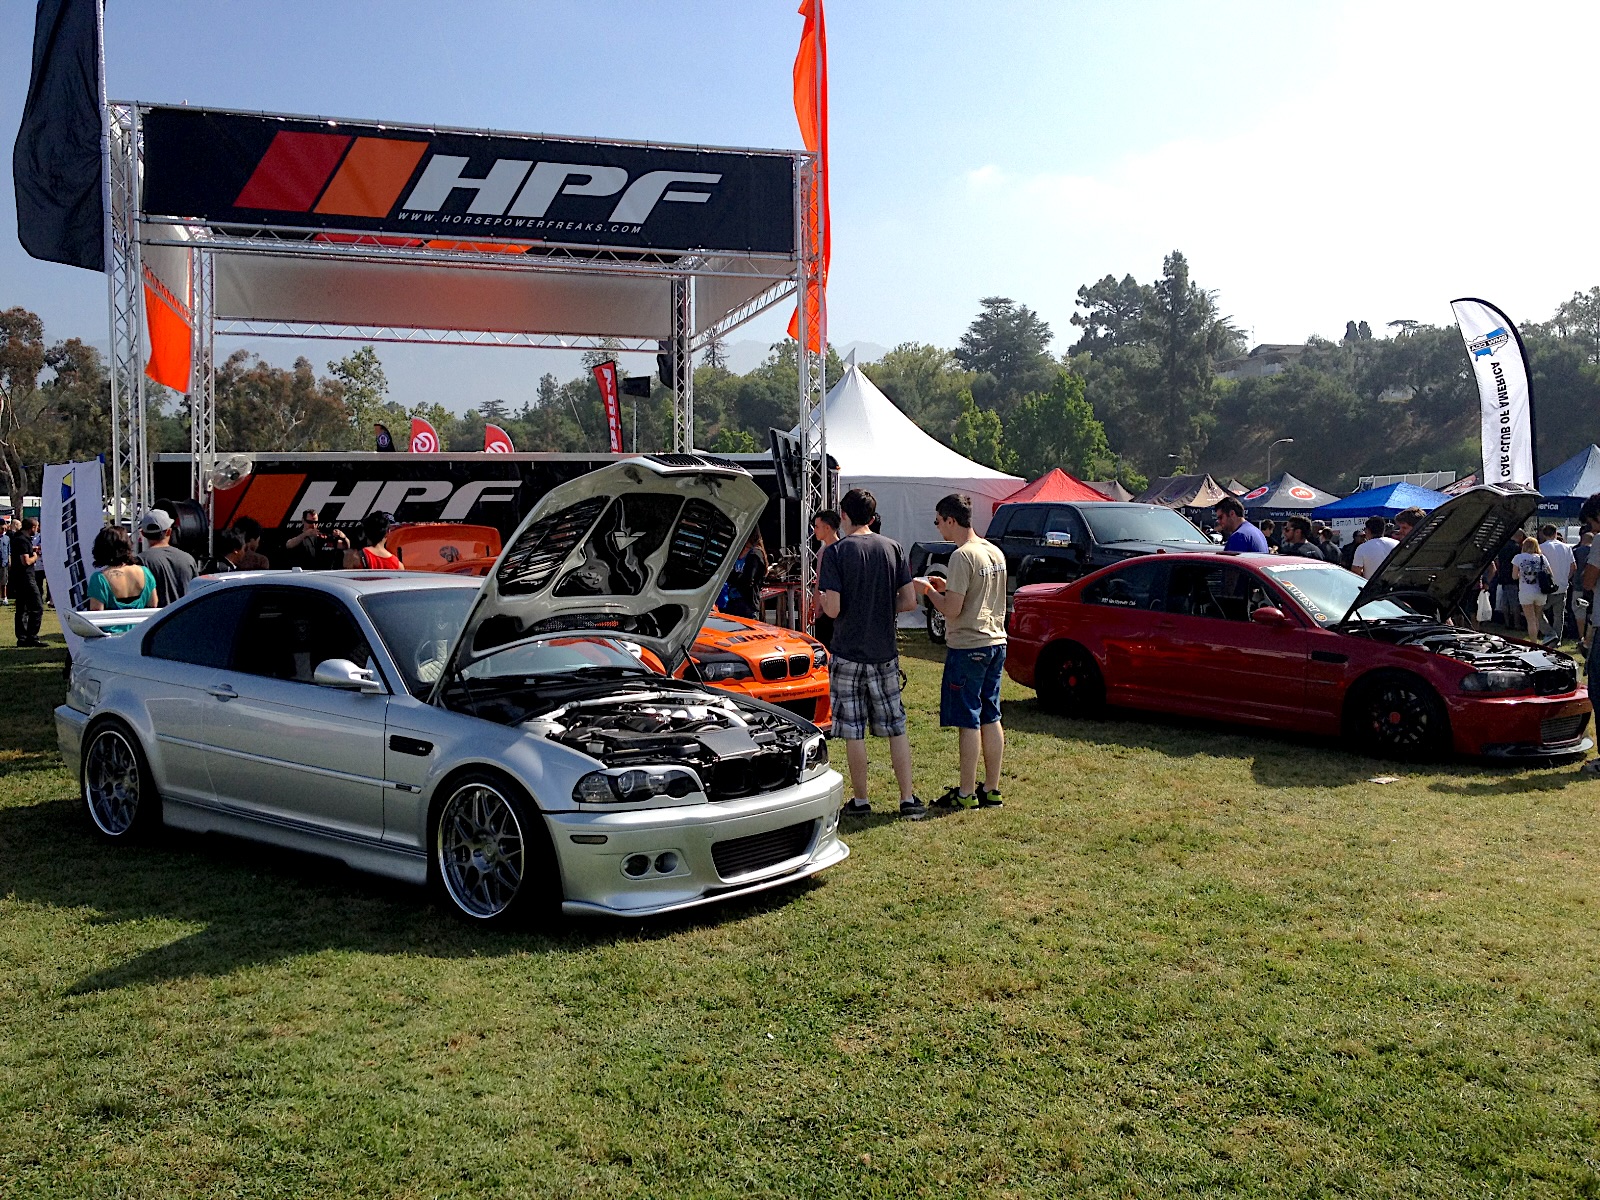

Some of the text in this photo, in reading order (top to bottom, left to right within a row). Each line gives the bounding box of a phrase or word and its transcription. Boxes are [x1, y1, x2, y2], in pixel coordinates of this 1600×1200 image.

[402, 154, 723, 224] HPF
[398, 212, 642, 234] WWW.HORSEPOWERFREAKS.COM
[290, 480, 523, 521] HPF
[1538, 501, 1559, 511] erica
